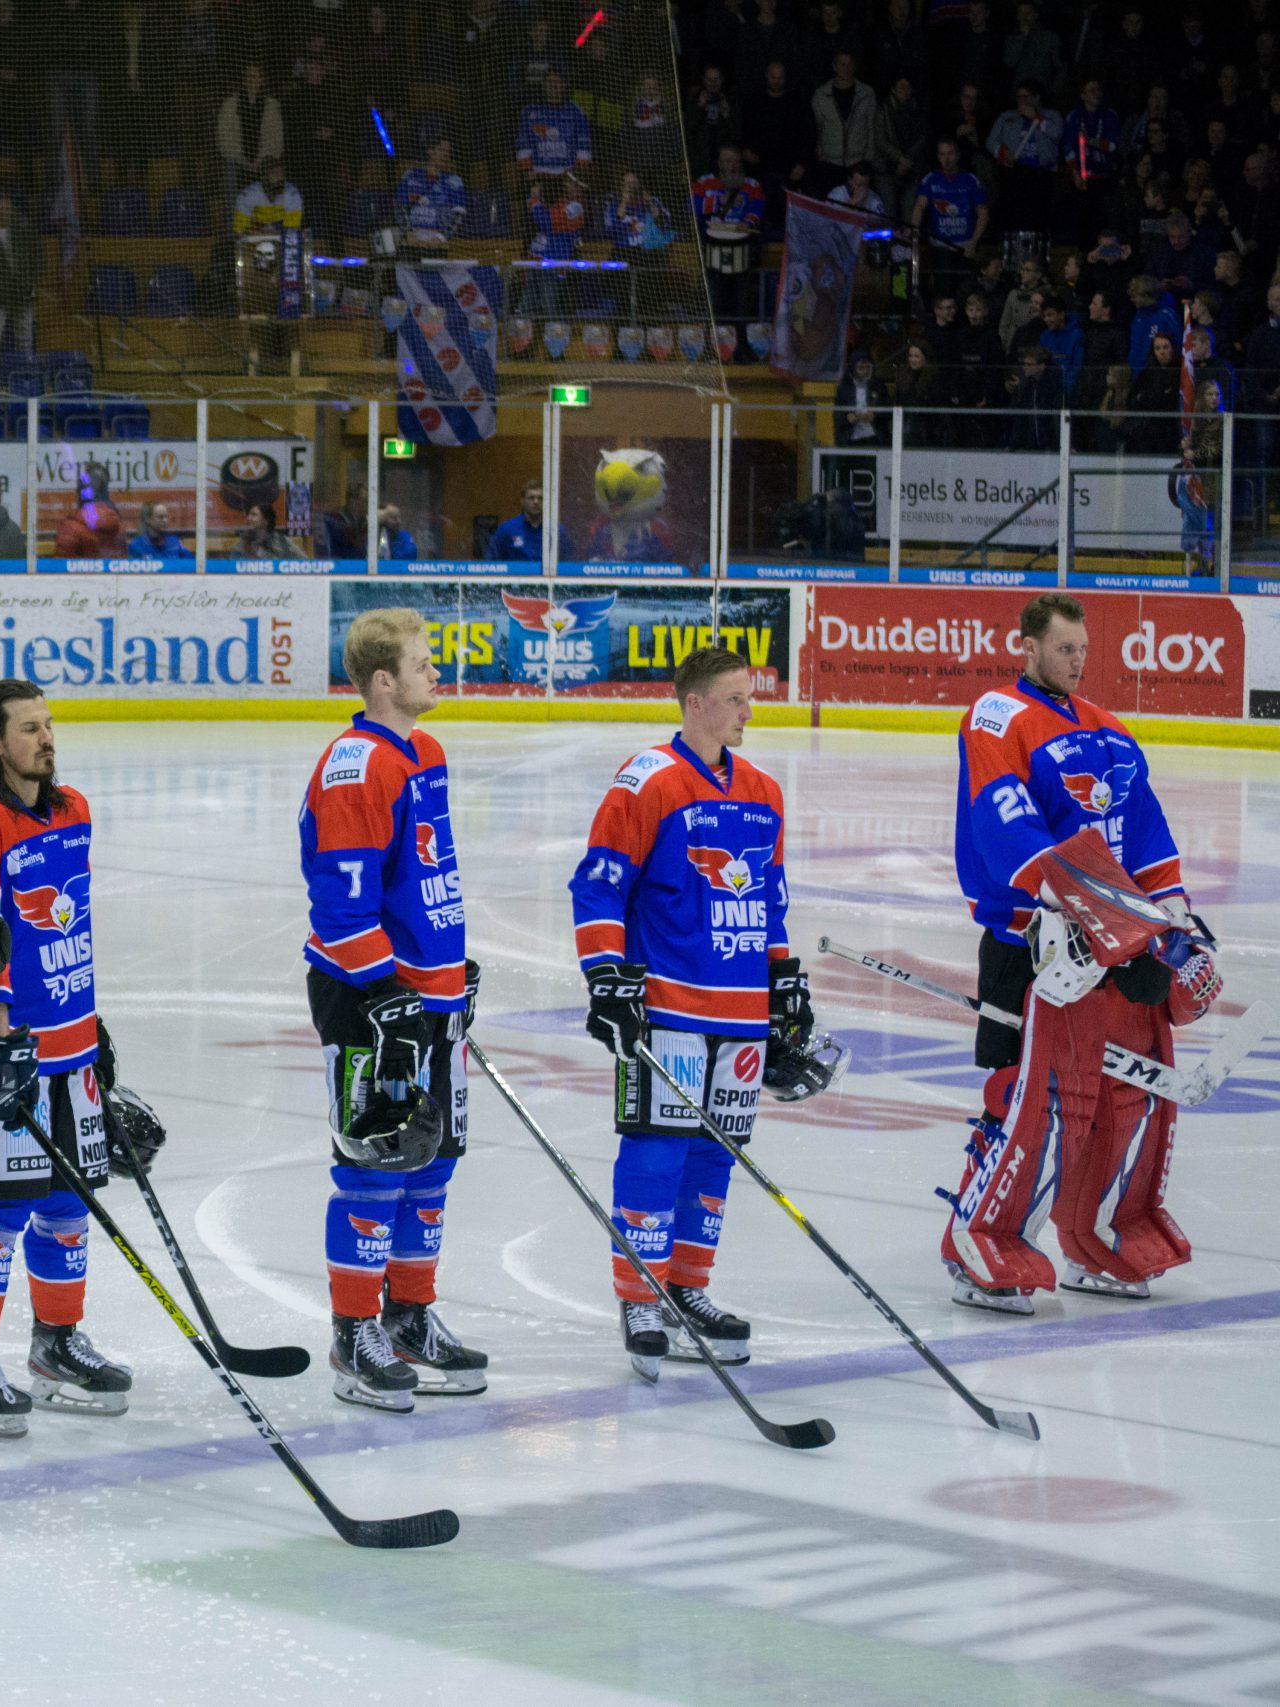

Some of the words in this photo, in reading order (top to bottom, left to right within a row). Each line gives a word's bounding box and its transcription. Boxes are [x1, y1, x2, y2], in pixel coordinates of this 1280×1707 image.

[953, 478, 968, 501] &
[975, 478, 1091, 506] Badkamrs
[900, 512, 954, 524] EERENVEEN
[66, 560, 104, 572] UNIS
[108, 560, 164, 572] GROUP
[235, 561, 274, 573] UNIS
[278, 561, 335, 573] GROUP
[407, 563, 454, 573] QUALITY
[468, 563, 508, 573] REPAIR
[583, 566, 630, 576] QUALITY
[643, 566, 683, 576] REPAIR
[757, 568, 803, 578] QUALITY
[816, 569, 856, 579] REPAIR
[929, 571, 966, 584] UNIS
[970, 571, 1025, 585] GROUP
[1095, 577, 1139, 587] QUALITY
[1151, 578, 1189, 588] REPAIR
[62, 589, 89, 612] die
[98, 592, 130, 608] van
[226, 590, 293, 609] houdt
[819, 615, 996, 664] Duidelijk
[271, 617, 293, 685] POST
[889, 661, 929, 677] logo's
[975, 666, 992, 677] en
[980, 697, 1016, 715] UNIS
[330, 744, 365, 763] UNIS
[326, 769, 360, 783] GROUP
[992, 782, 1039, 824] 21
[42, 834, 59, 843] CCM
[338, 860, 364, 899] 7
[710, 900, 767, 928] UNIS
[1064, 894, 1121, 951] CCM
[39, 931, 92, 974] UNIS
[711, 930, 768, 961] FLYERS
[861, 955, 912, 981] CCM
[380, 1001, 421, 1022] CC
[662, 1054, 705, 1088] UNIS
[982, 1144, 1025, 1226] CCM
[625, 1229, 669, 1242] UNIS
[113, 1235, 139, 1268] SUPER
[138, 1264, 178, 1317] TACKS
